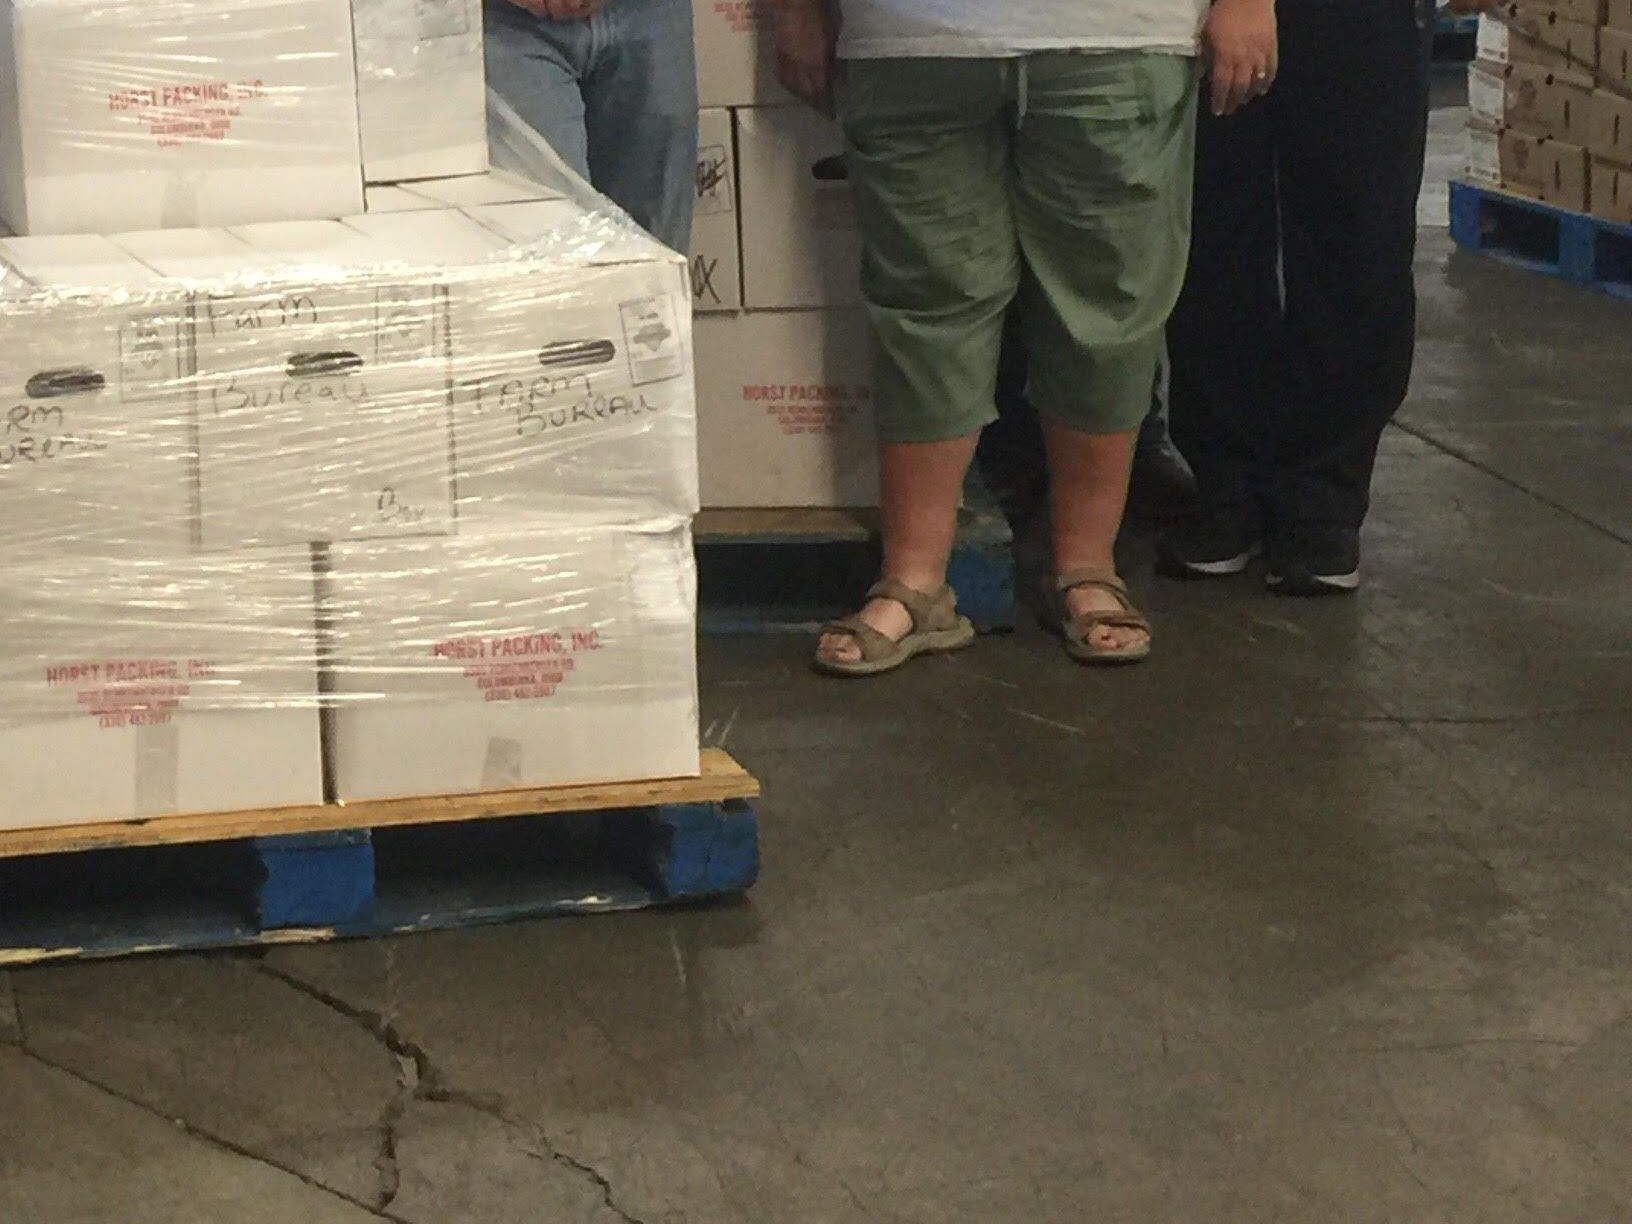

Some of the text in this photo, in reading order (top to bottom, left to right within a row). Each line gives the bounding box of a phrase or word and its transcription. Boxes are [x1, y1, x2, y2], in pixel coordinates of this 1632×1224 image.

[743, 384, 785, 401] HORST
[433, 636, 486, 660] HORST
[46, 663, 101, 686] HORST
